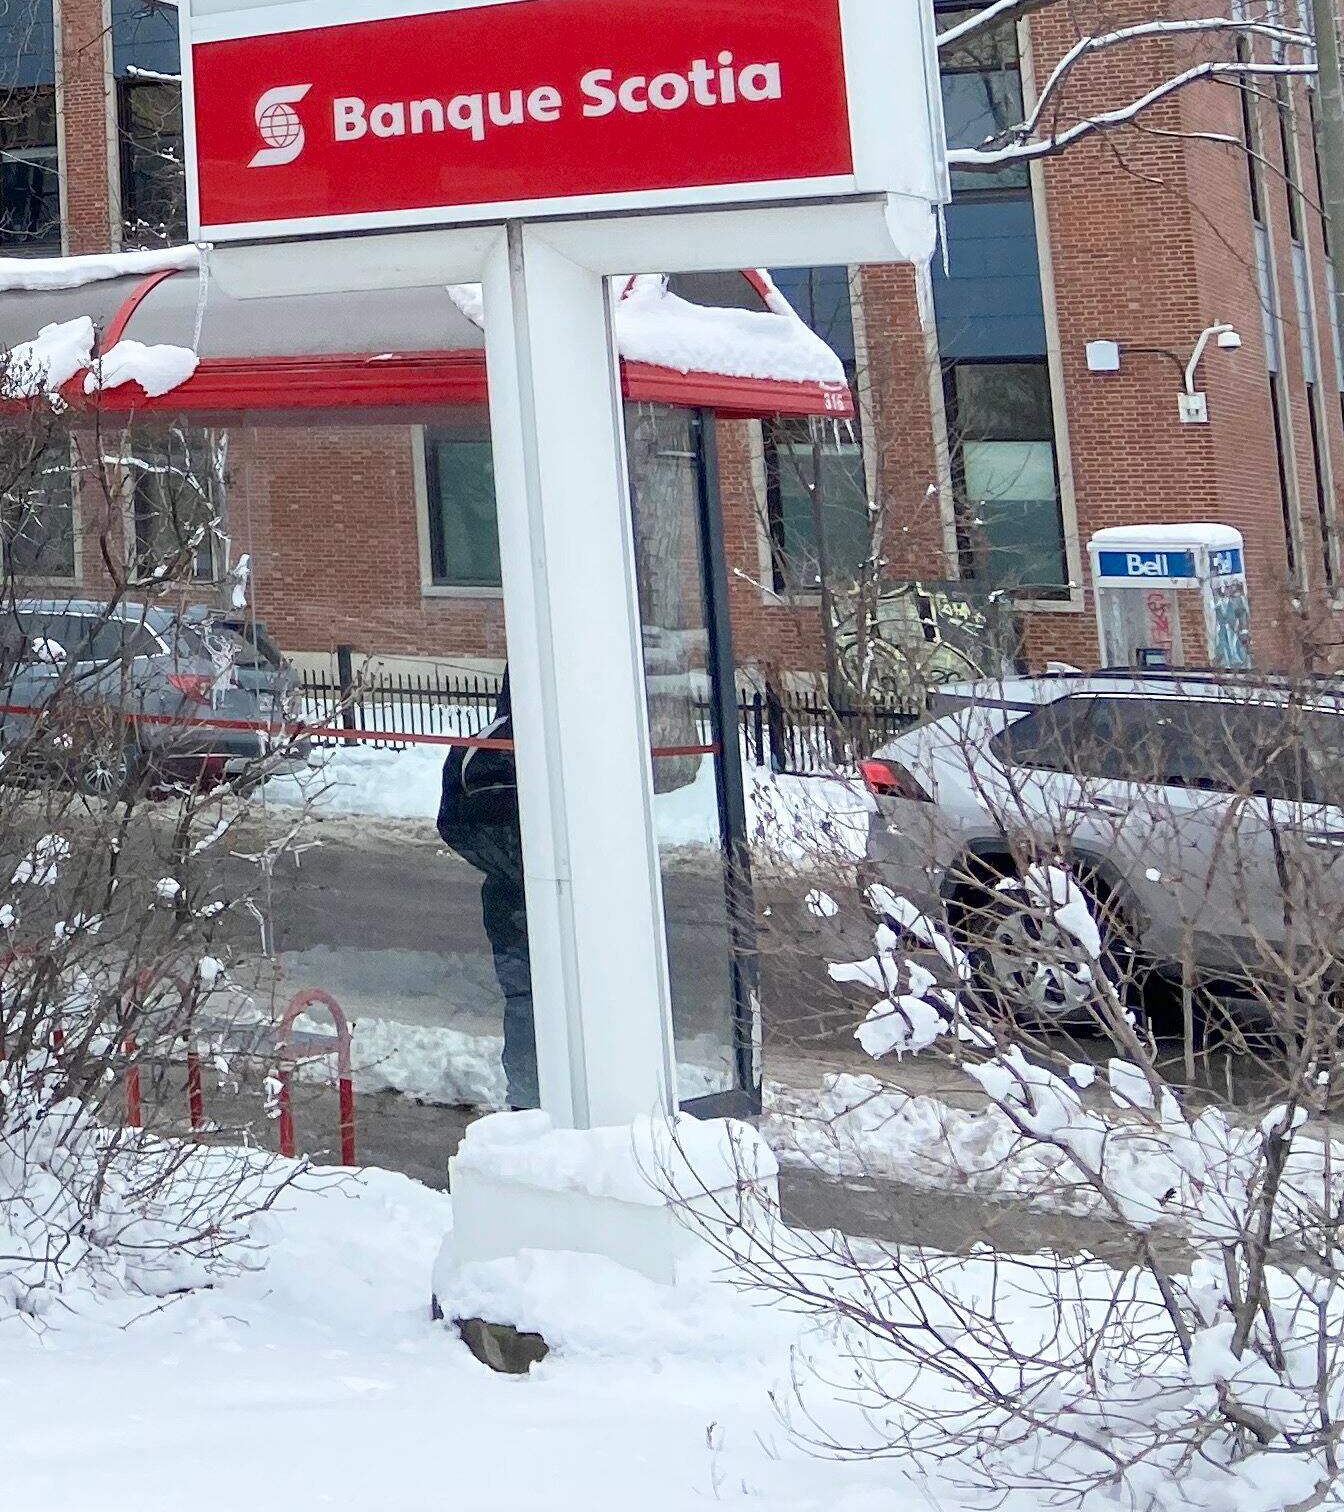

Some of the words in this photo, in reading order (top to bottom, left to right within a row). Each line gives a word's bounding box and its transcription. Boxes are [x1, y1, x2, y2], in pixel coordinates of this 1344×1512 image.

[333, 85, 562, 142] Banque
[580, 50, 783, 119] Scotia
[1126, 553, 1169, 576] Bell
